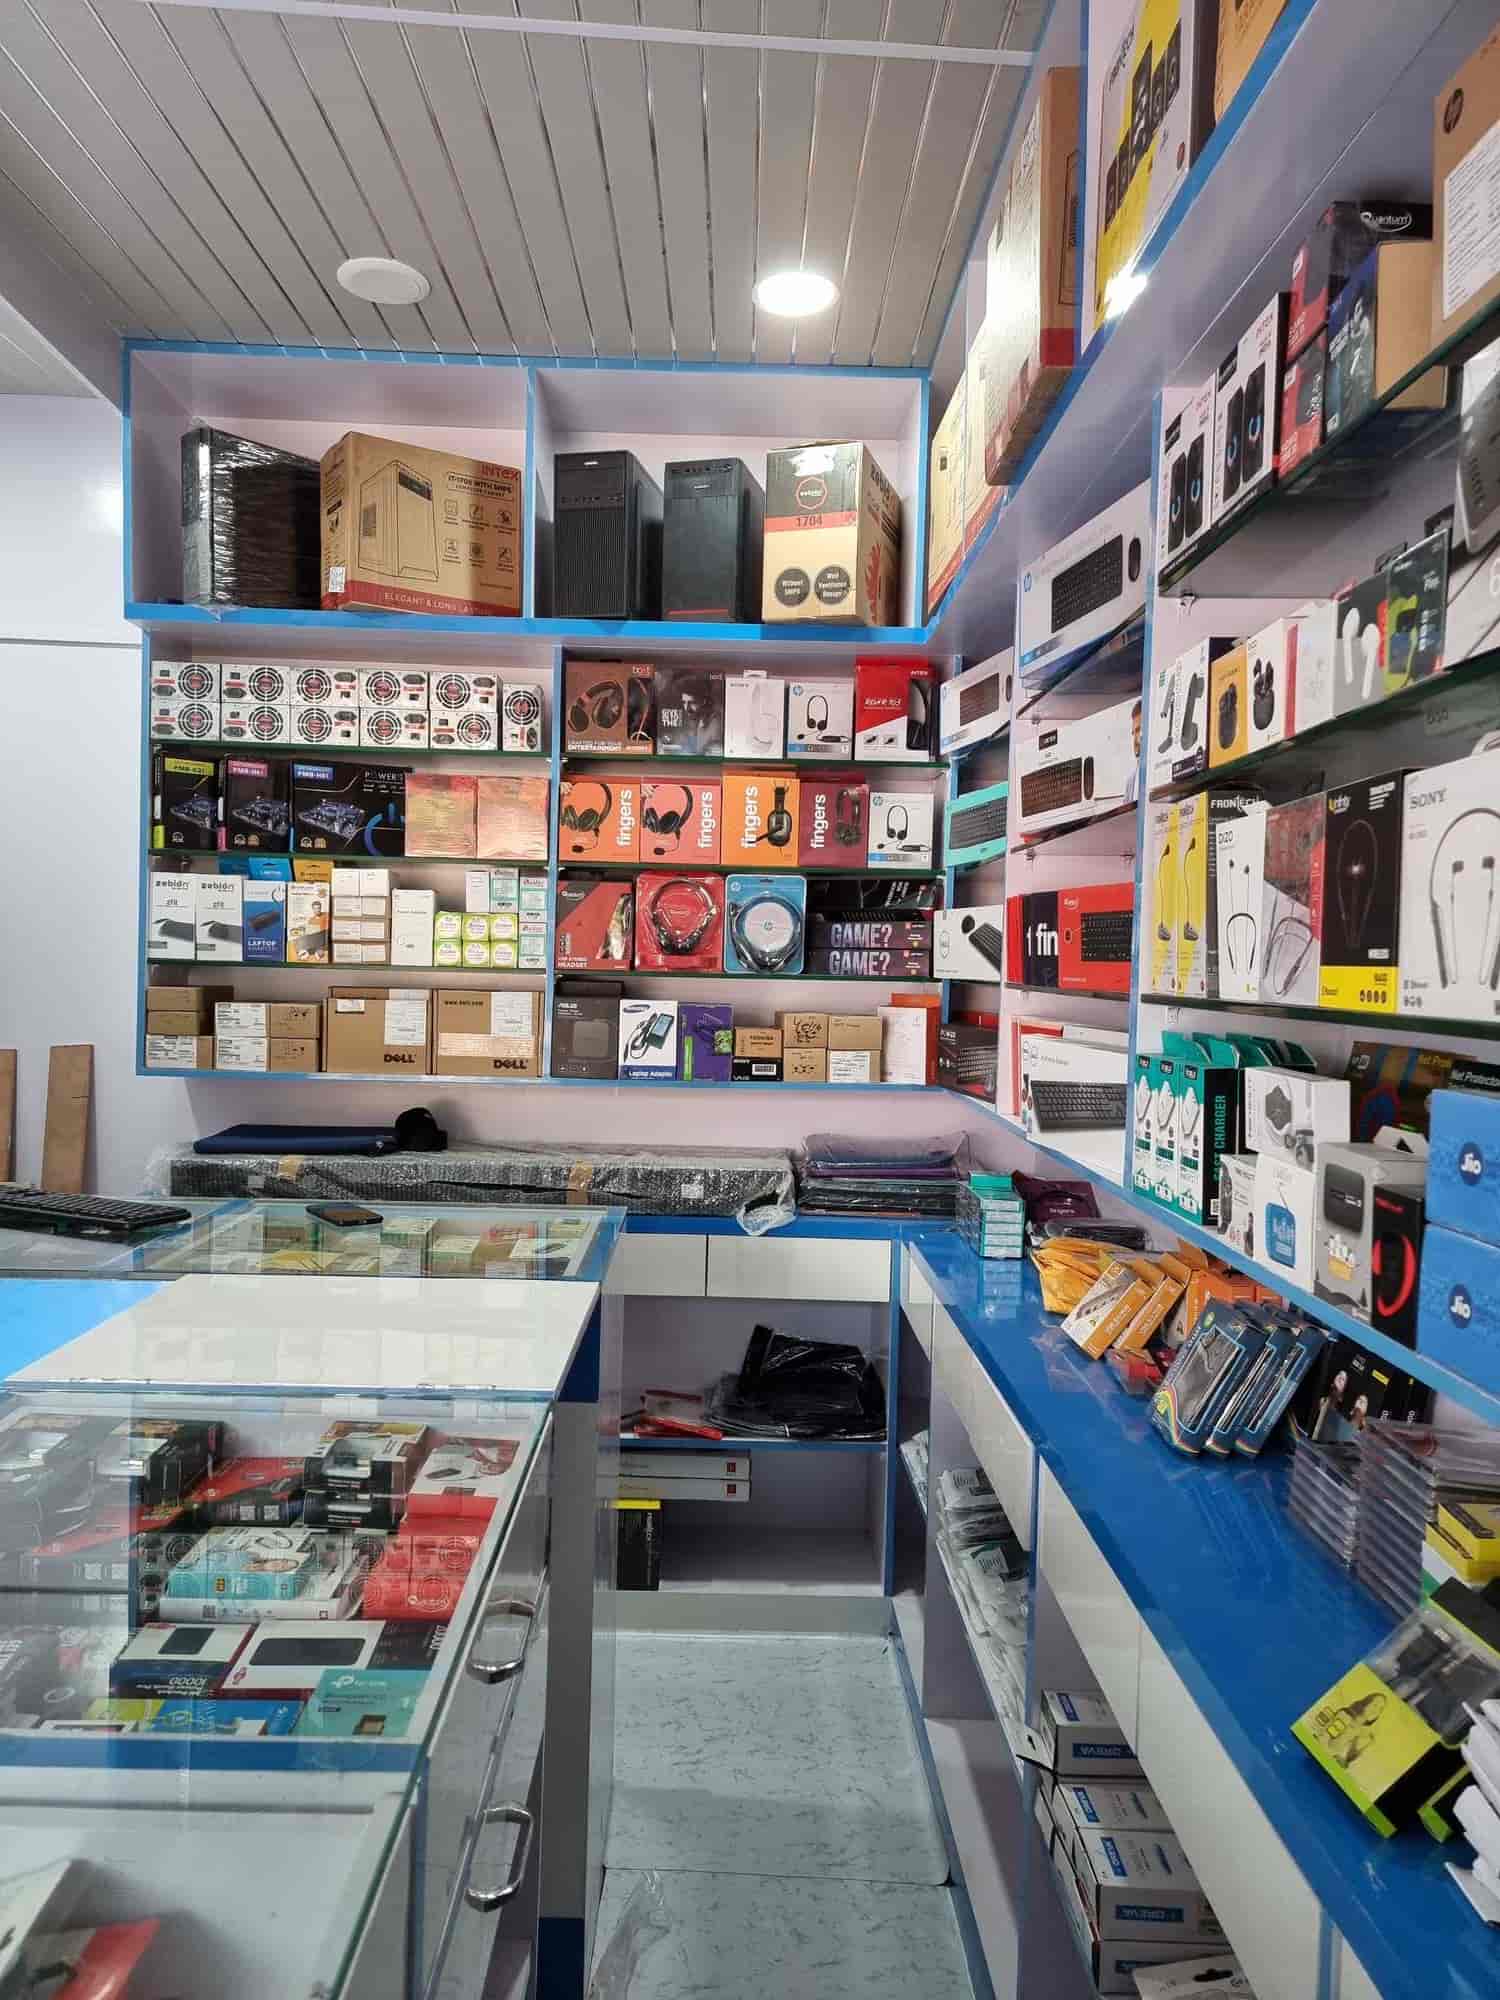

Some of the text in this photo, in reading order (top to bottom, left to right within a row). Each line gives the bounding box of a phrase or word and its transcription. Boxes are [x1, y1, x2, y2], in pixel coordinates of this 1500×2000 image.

[1360, 211, 1412, 231] Quantum
[481, 463, 519, 481] INTEX
[1409, 788, 1447, 809] SONY
[617, 789, 636, 847] fingers
[697, 791, 716, 848] fingers
[741, 785, 761, 848] fingers
[810, 794, 830, 849] fingers
[830, 922, 893, 948] GAME?
[828, 951, 891, 975] GAME?
[384, 1054, 416, 1064] DELL
[493, 1059, 528, 1069] DELL
[1213, 1095, 1226, 1150] CHARGER
[1460, 1154, 1483, 1176] Jio
[1450, 1297, 1472, 1318] Jio
